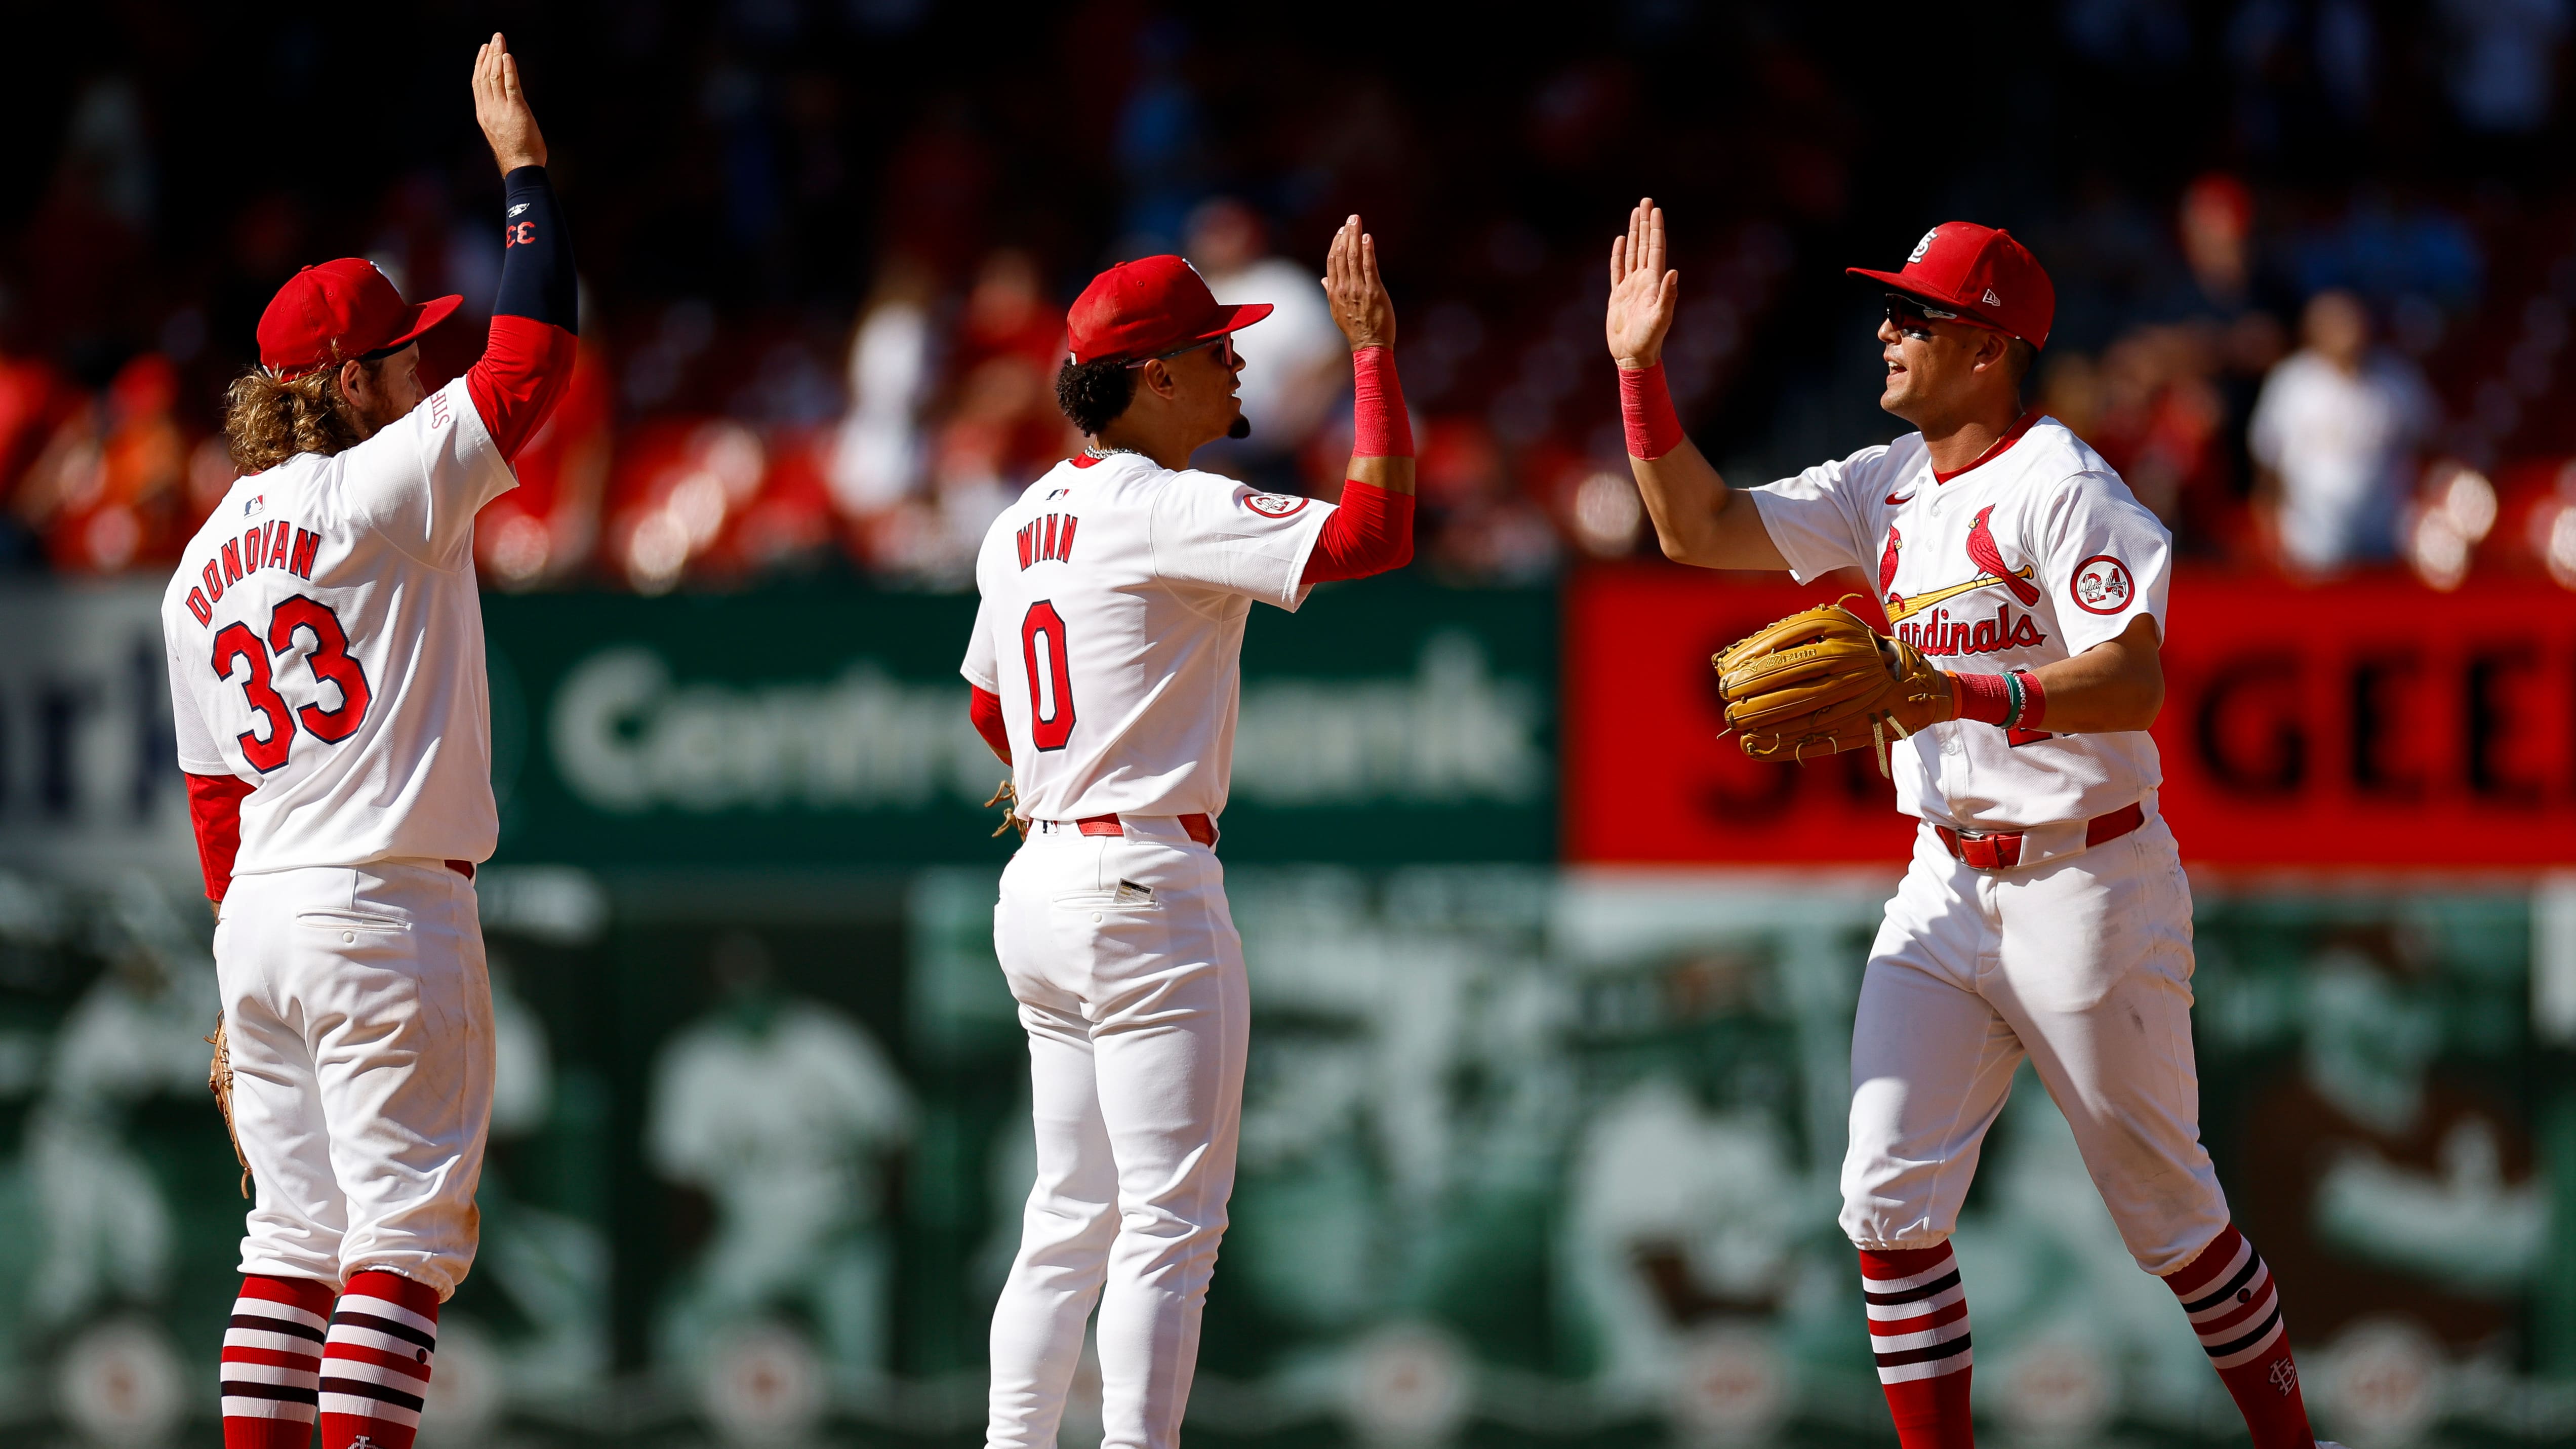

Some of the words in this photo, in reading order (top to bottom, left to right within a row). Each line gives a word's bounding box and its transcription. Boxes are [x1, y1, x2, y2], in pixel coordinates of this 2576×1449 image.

[185, 520, 321, 629] DONOVAN
[1017, 512, 1078, 572] WINN
[2082, 568, 2124, 604] 24
[1893, 602, 2047, 657] ardinals
[211, 593, 372, 775] 33
[1021, 598, 1077, 753] 0
